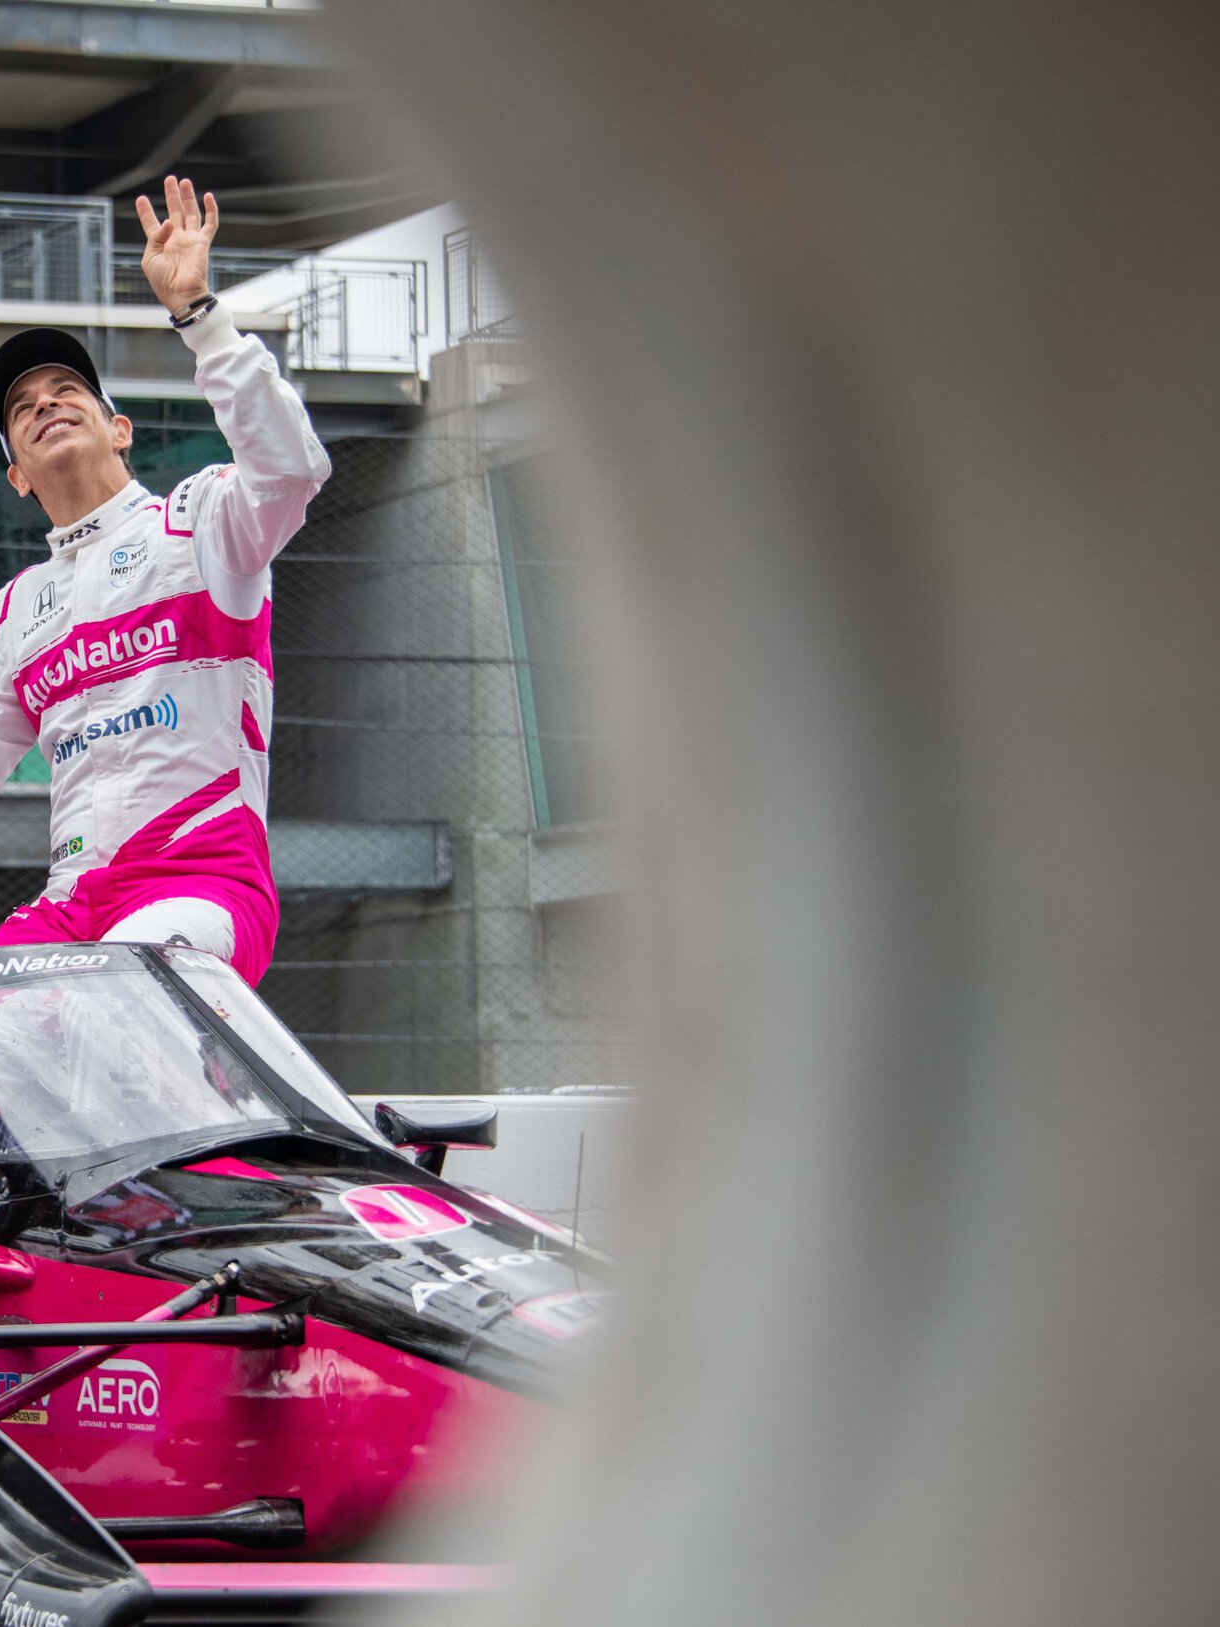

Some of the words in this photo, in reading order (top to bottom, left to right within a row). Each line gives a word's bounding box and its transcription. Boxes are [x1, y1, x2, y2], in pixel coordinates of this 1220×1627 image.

[59, 518, 101, 548] HRX
[110, 554, 148, 577] INDYCAR
[130, 547, 146, 561] NTT
[22, 606, 64, 640] HONDA
[22, 618, 177, 716] AutoNation
[76, 1376, 159, 1417] AERO
[0, 1591, 70, 1627] fixtures
